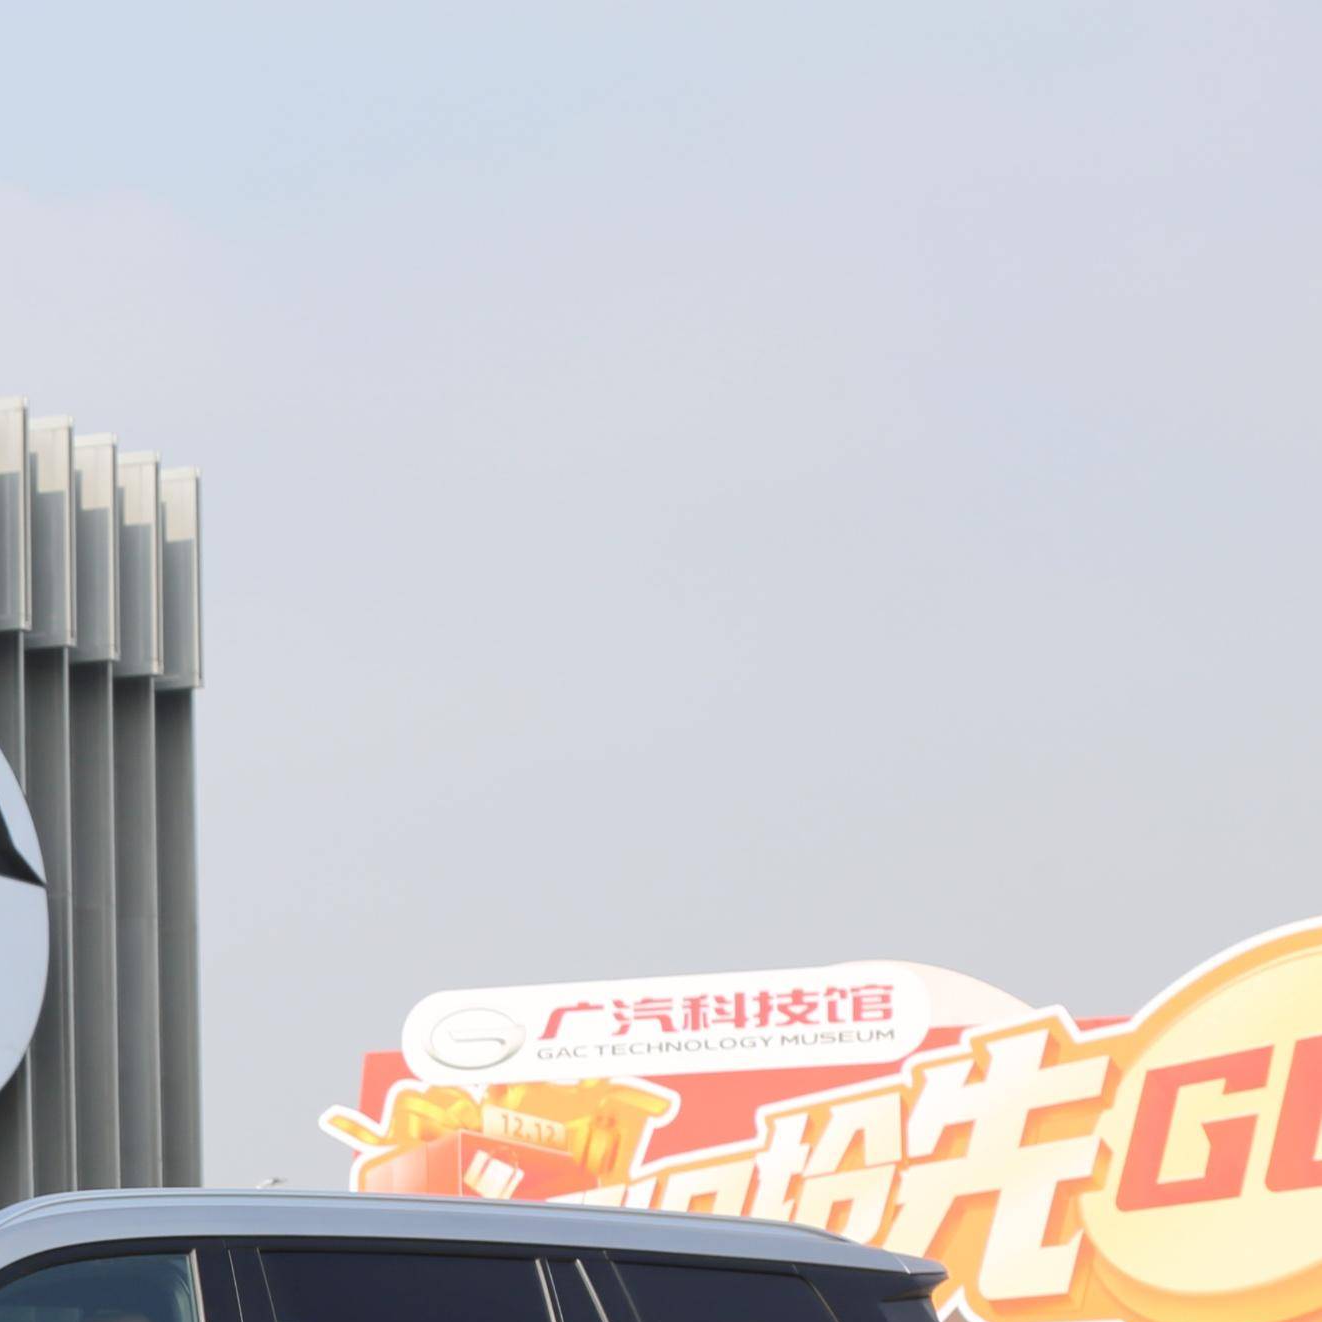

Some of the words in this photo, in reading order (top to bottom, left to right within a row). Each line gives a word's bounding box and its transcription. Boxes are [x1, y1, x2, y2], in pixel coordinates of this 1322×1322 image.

[538, 984, 895, 1040] 广汽科技馆
[537, 1045, 588, 1060] GAC
[595, 1035, 773, 1056] TECHNOLOGY
[780, 1028, 895, 1046] MUSEUM
